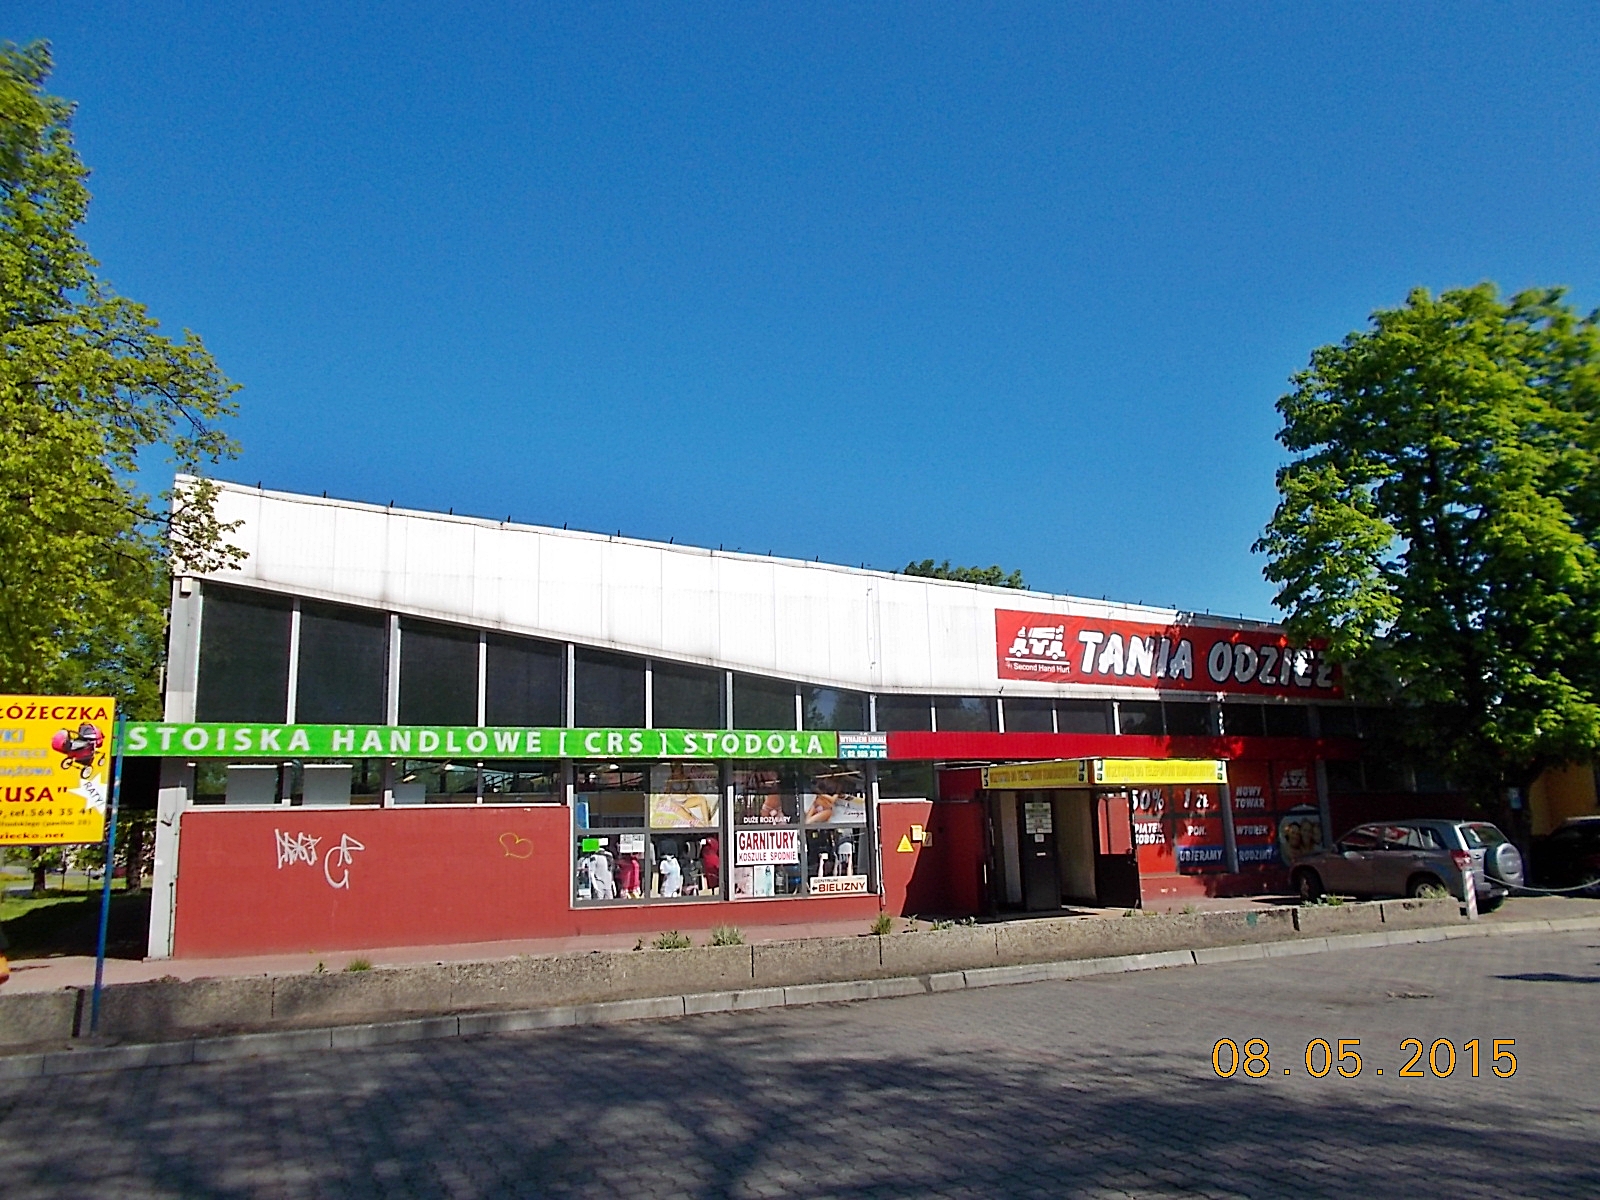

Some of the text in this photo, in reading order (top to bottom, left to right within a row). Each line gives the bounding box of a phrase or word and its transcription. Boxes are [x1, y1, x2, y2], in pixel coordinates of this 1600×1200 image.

[1078, 629, 1193, 680] TANIA
[1013, 662, 1037, 671] Second
[1038, 664, 1055, 672] Hand
[1056, 665, 1070, 673] Hurt
[0, 702, 108, 720] ÓŻECZKA
[128, 727, 311, 752] STOISKA
[332, 728, 541, 754] HANDLOWE
[585, 732, 644, 754] CRS
[683, 732, 823, 755] STODOŁA
[840, 735, 887, 743] WYNAJEM LOKALI
[0, 786, 67, 802] USA"
[1236, 786, 1262, 797] NOWY
[1235, 798, 1265, 808] TOWAR
[743, 815, 759, 824] DUŻE
[738, 832, 795, 850] GARNITURY
[738, 851, 797, 862] KOSZULE SPODNIE
[1180, 849, 1222, 862] UBIERAMY
[818, 881, 866, 892] BIELIZNY
